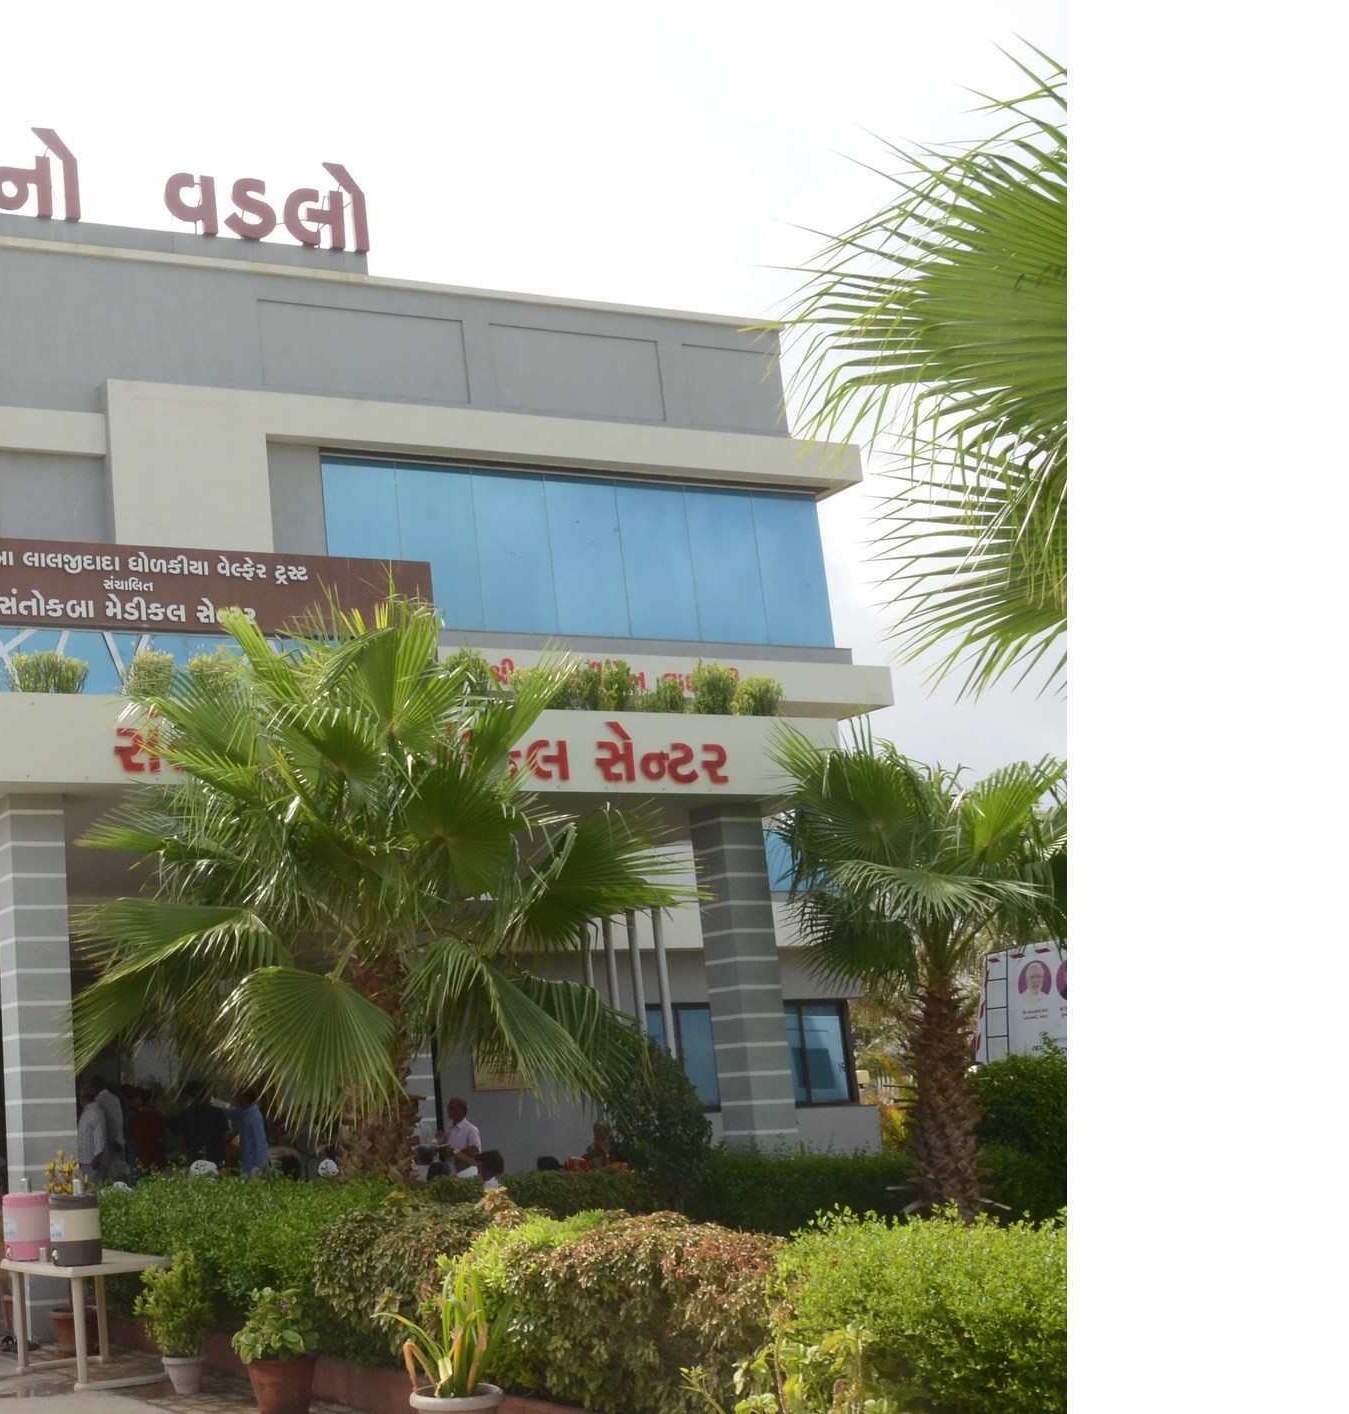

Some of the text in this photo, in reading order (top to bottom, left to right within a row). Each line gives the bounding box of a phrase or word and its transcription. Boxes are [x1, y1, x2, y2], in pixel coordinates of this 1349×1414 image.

[164, 162, 370, 254] વડલો
[22, 551, 120, 574] લાલજીદાદા
[216, 555, 267, 581] વેલ્ફેર
[274, 564, 309, 585] ટ્રસ્ટ
[103, 575, 154, 592] સંચાલિત
[105, 593, 186, 623] મેડીકલ
[595, 721, 729, 784] સેન્ટર
